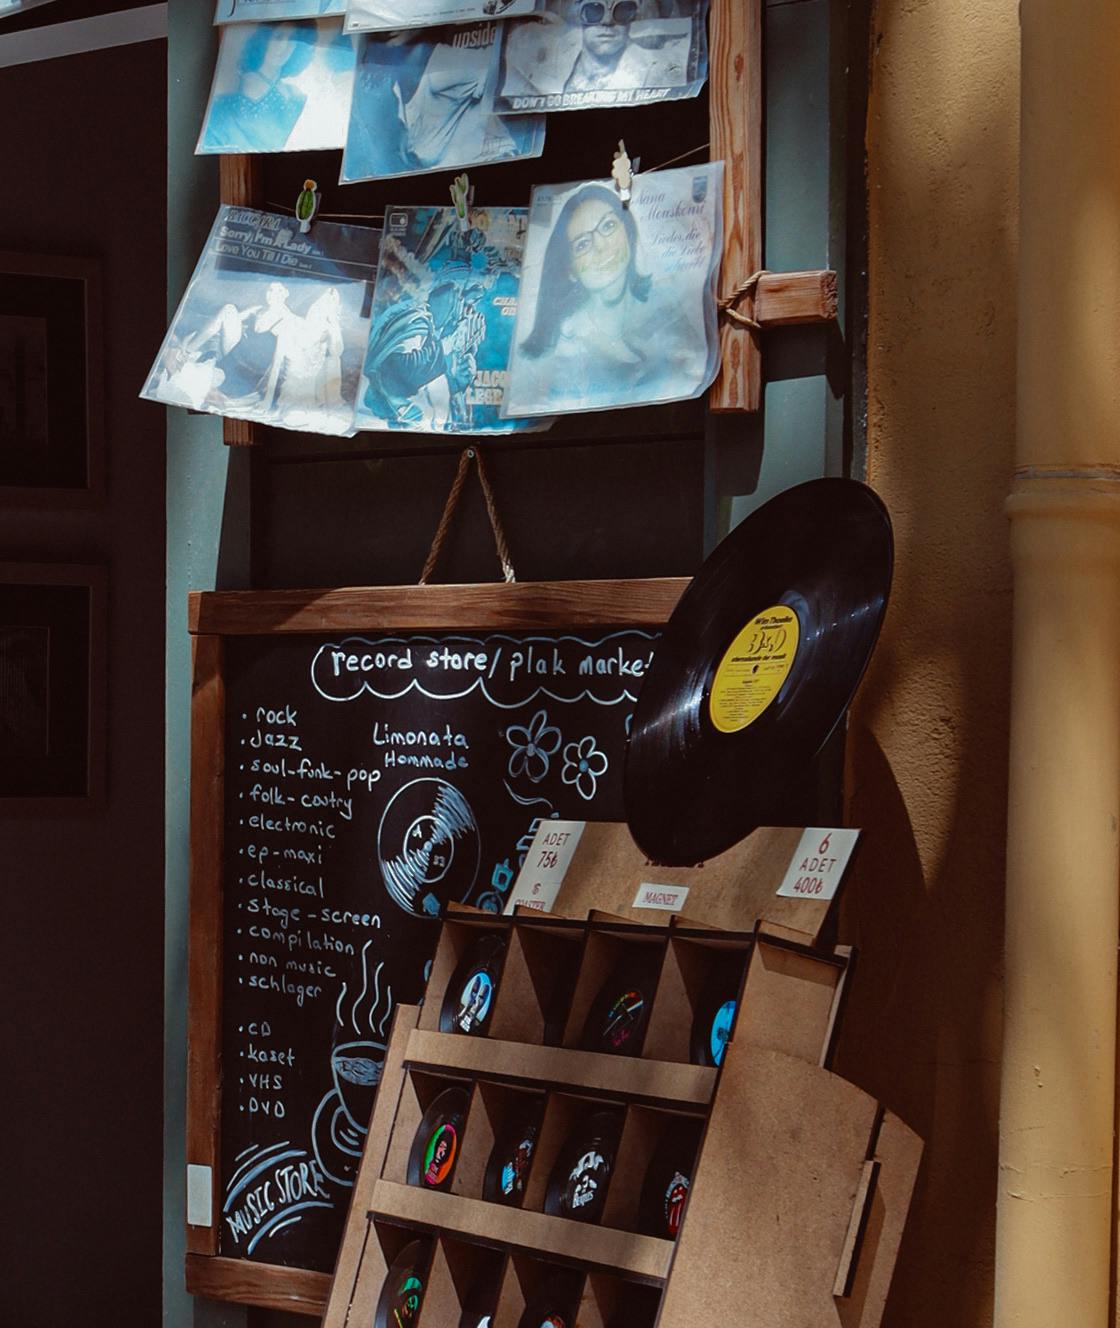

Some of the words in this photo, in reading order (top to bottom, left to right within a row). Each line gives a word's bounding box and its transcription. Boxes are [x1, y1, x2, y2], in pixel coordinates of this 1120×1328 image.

[512, 97, 545, 110] DON'T
[546, 94, 562, 108] GO
[635, 87, 672, 101] HEART
[220, 226, 253, 244] Sorry,
[255, 229, 273, 245] I'm
[283, 240, 312, 255] Lady
[241, 244, 261, 258] You
[332, 647, 413, 677] record
[510, 648, 567, 682] plak
[256, 704, 298, 727] rock
[373, 722, 470, 750] Limonata
[384, 750, 470, 771] Hommade
[248, 813, 336, 839] electronic
[542, 832, 571, 847] ADET
[818, 832, 832, 855] 6
[799, 857, 837, 873] ADET
[247, 870, 325, 900] classical
[249, 924, 355, 956] compilation
[249, 951, 278, 968] non
[286, 960, 337, 978] music
[248, 973, 323, 1008] schlager
[248, 1021, 272, 1038] CD
[248, 1042, 296, 1068] kaset
[248, 1072, 283, 1090] VHS
[248, 1096, 286, 1119] DVD
[225, 1180, 276, 1245] MUSIC
[274, 1159, 331, 1204] STORE
